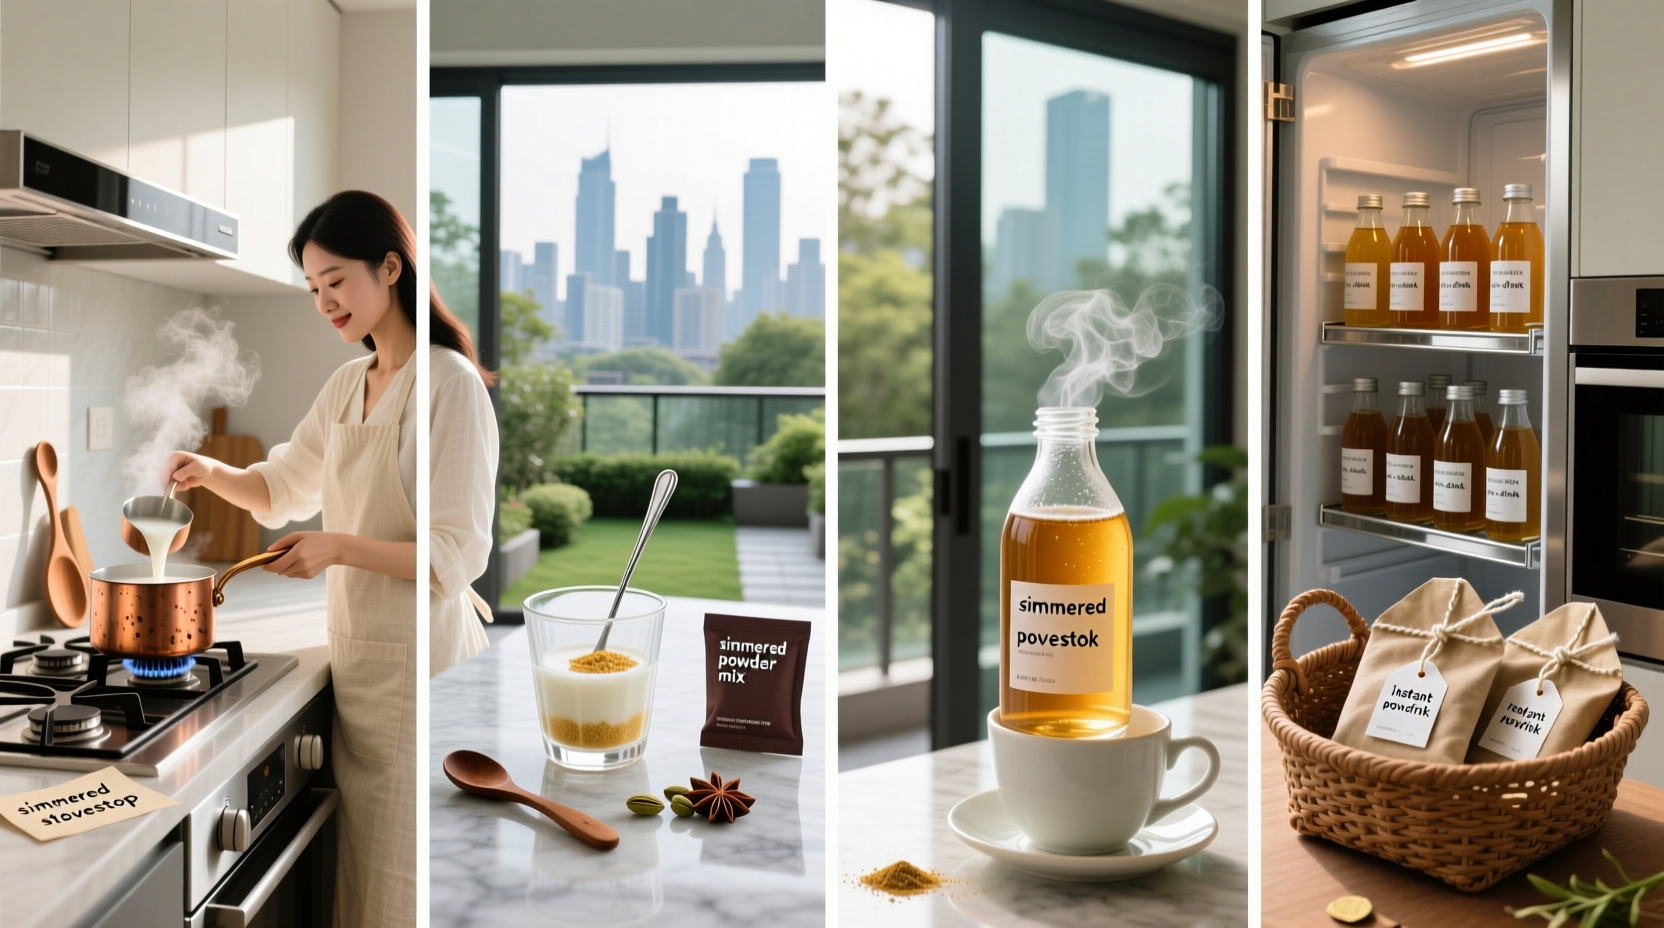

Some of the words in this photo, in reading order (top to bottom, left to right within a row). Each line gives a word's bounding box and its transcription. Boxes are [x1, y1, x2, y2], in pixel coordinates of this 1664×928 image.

[1018, 595, 1107, 615] simmered
[1017, 629, 1099, 648] povestok
[718, 669, 746, 684] mix
[18, 782, 111, 815] simmered
